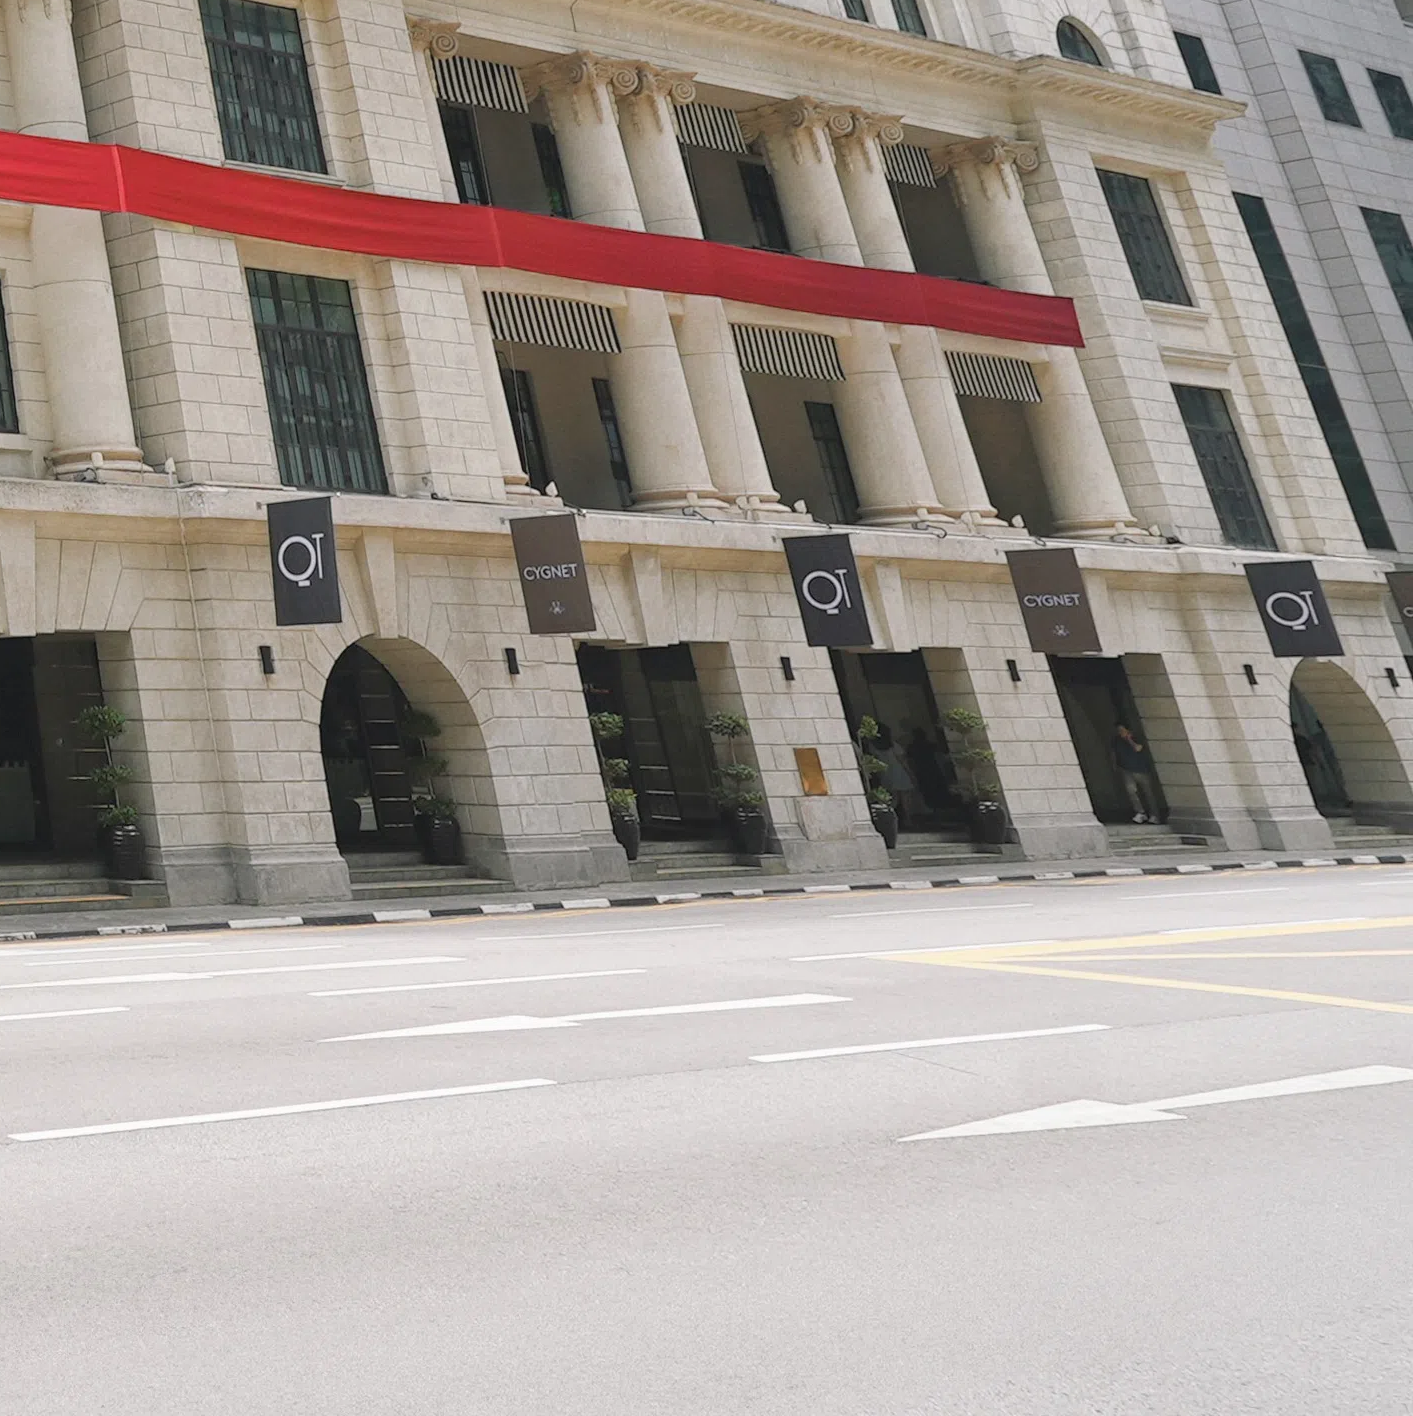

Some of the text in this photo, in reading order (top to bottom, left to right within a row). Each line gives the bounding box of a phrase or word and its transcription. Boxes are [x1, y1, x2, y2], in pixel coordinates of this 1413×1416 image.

[278, 533, 324, 587] QT
[523, 563, 577, 581] CYGNET
[802, 569, 851, 615] QT
[1023, 594, 1080, 607] CYGNET
[1266, 591, 1319, 630] QT
